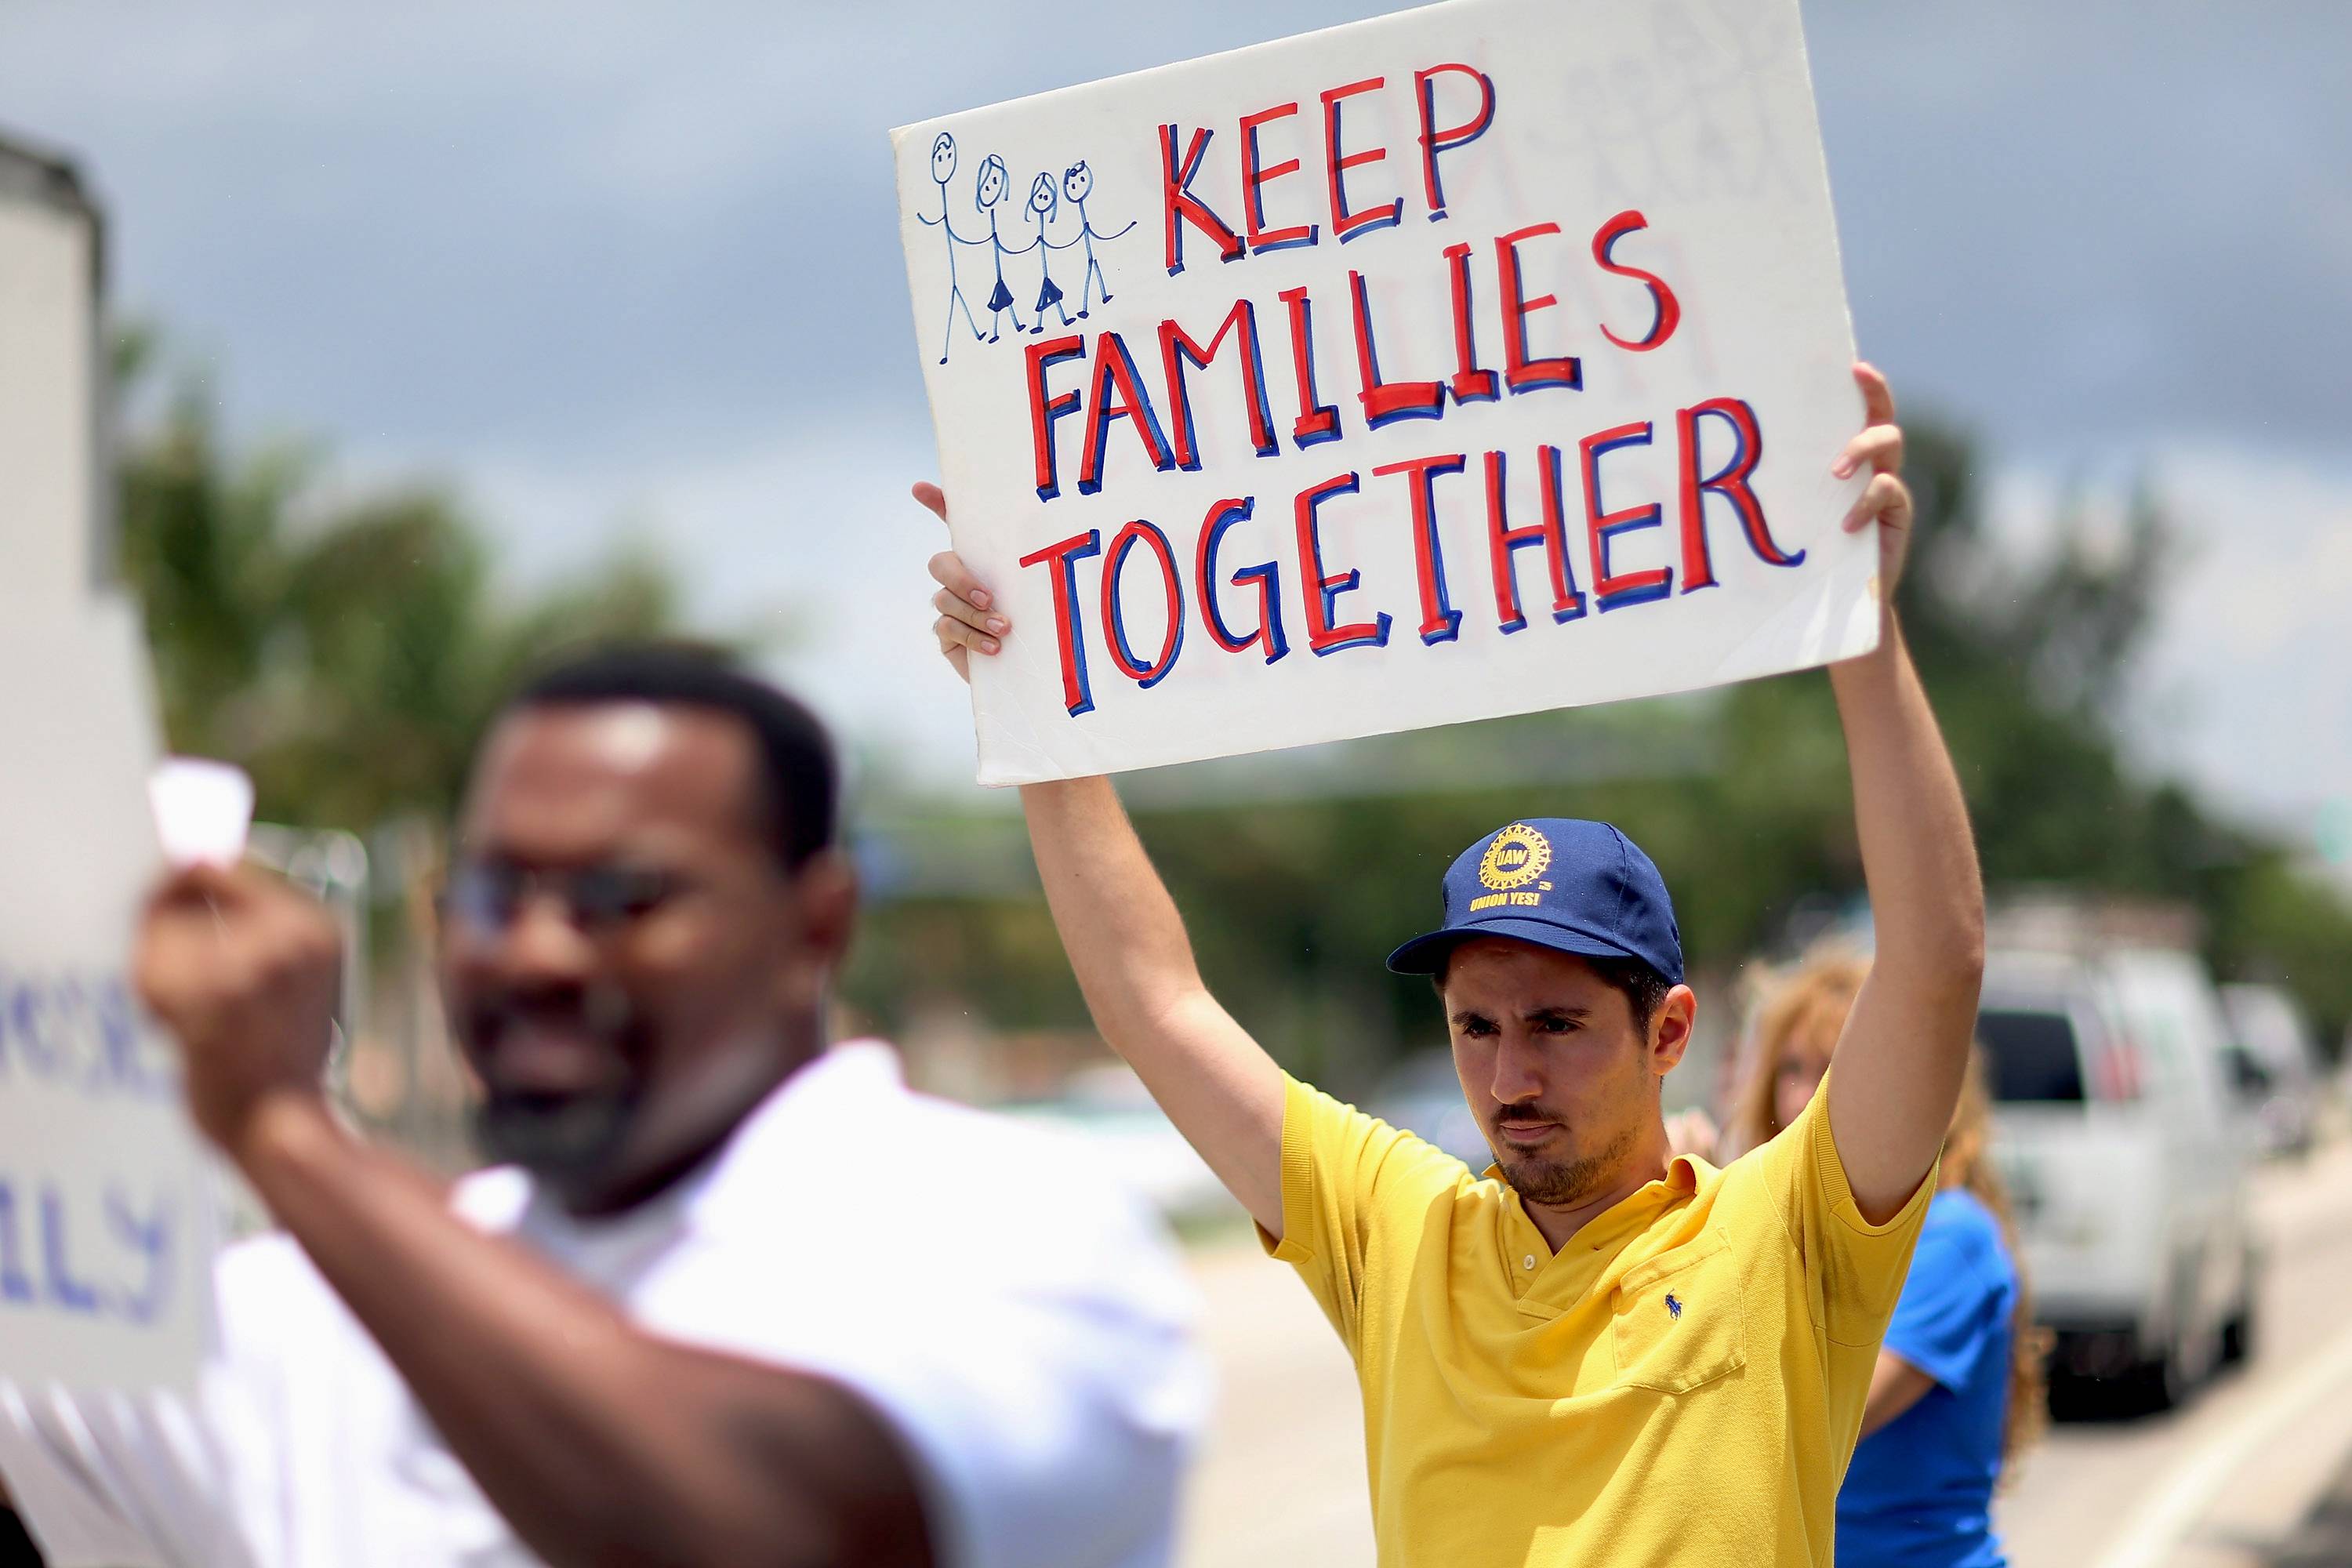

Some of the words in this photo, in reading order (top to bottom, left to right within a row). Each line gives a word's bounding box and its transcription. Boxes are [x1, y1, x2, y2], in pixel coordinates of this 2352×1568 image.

[1159, 64, 1496, 278] KEEP
[1025, 210, 1681, 503] FAMILIES
[1018, 397, 1806, 718] TOGETHER
[1470, 893, 1508, 912] UNION
[1510, 892, 1541, 906] YES!
[1497, 849, 1528, 866] UAW
